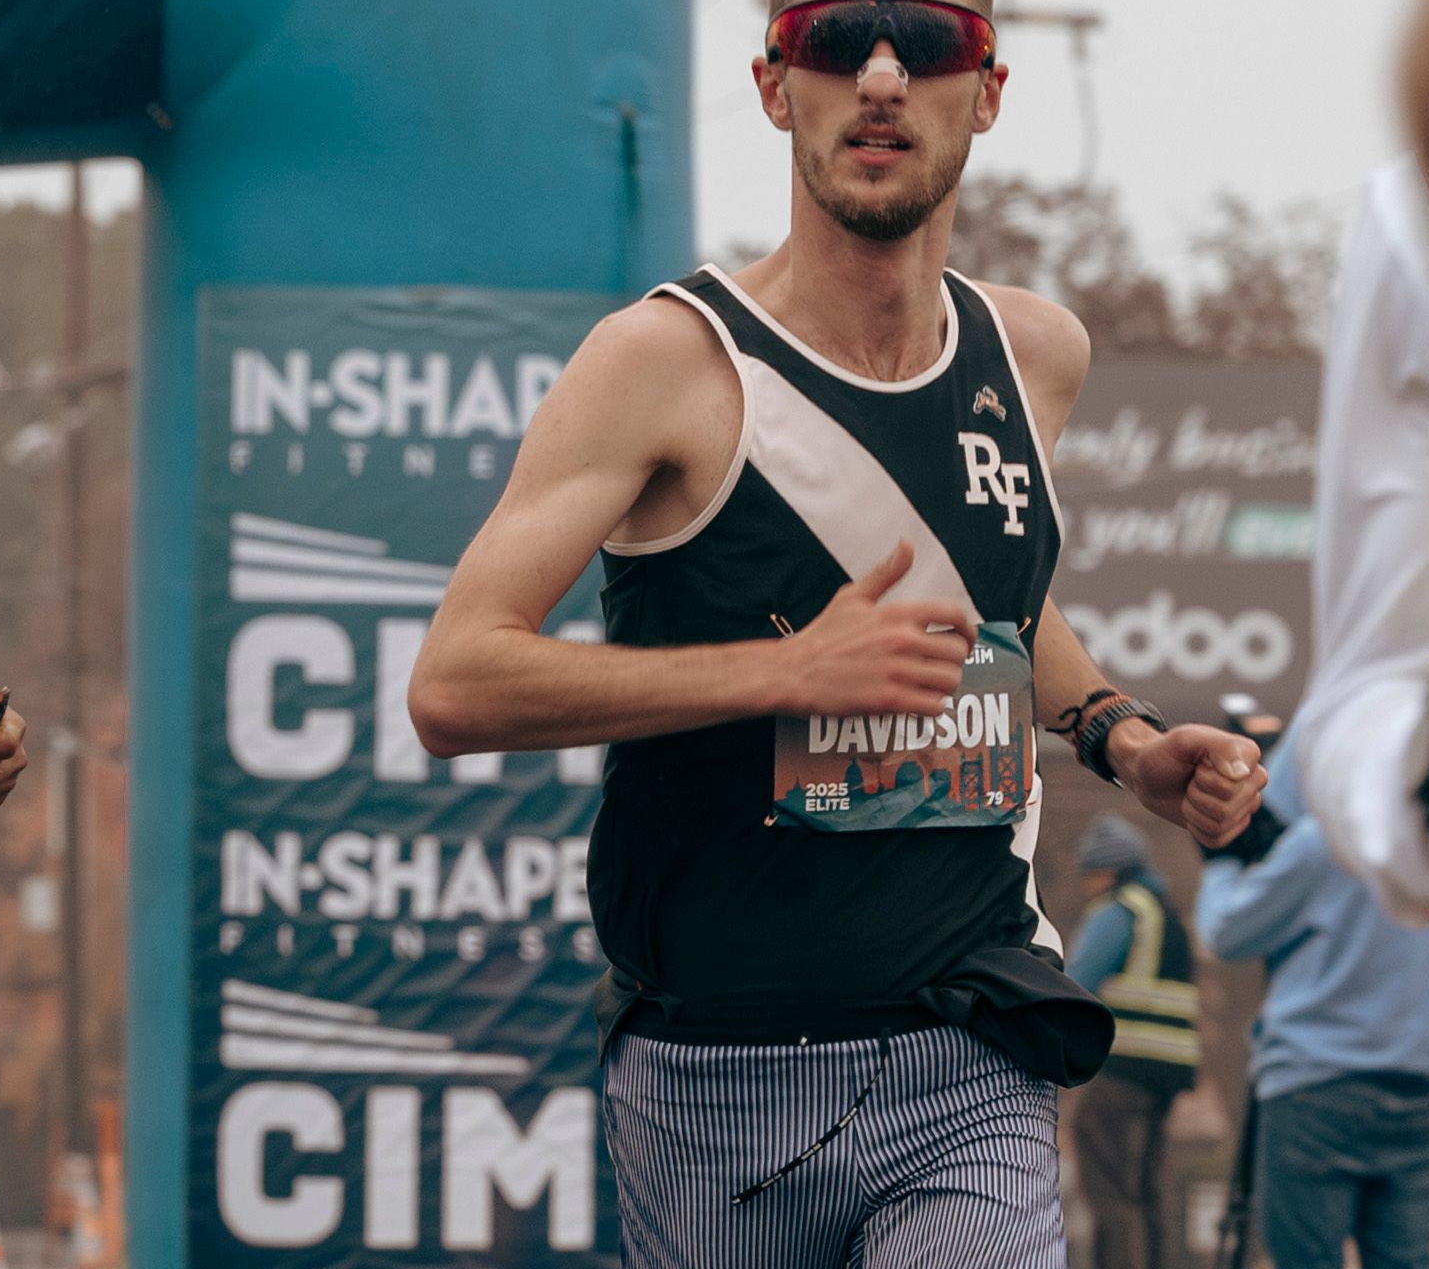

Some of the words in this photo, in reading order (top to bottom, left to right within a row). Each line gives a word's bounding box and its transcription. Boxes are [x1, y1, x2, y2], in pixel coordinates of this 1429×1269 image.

[230, 346, 564, 441] IN-SHAP
[229, 439, 498, 480] FITNE
[807, 692, 1011, 755] DAVIDSON
[805, 783, 849, 797] 2025
[805, 797, 850, 812] ELITE
[985, 790, 1004, 806] 79
[216, 1080, 599, 1253] CIM
